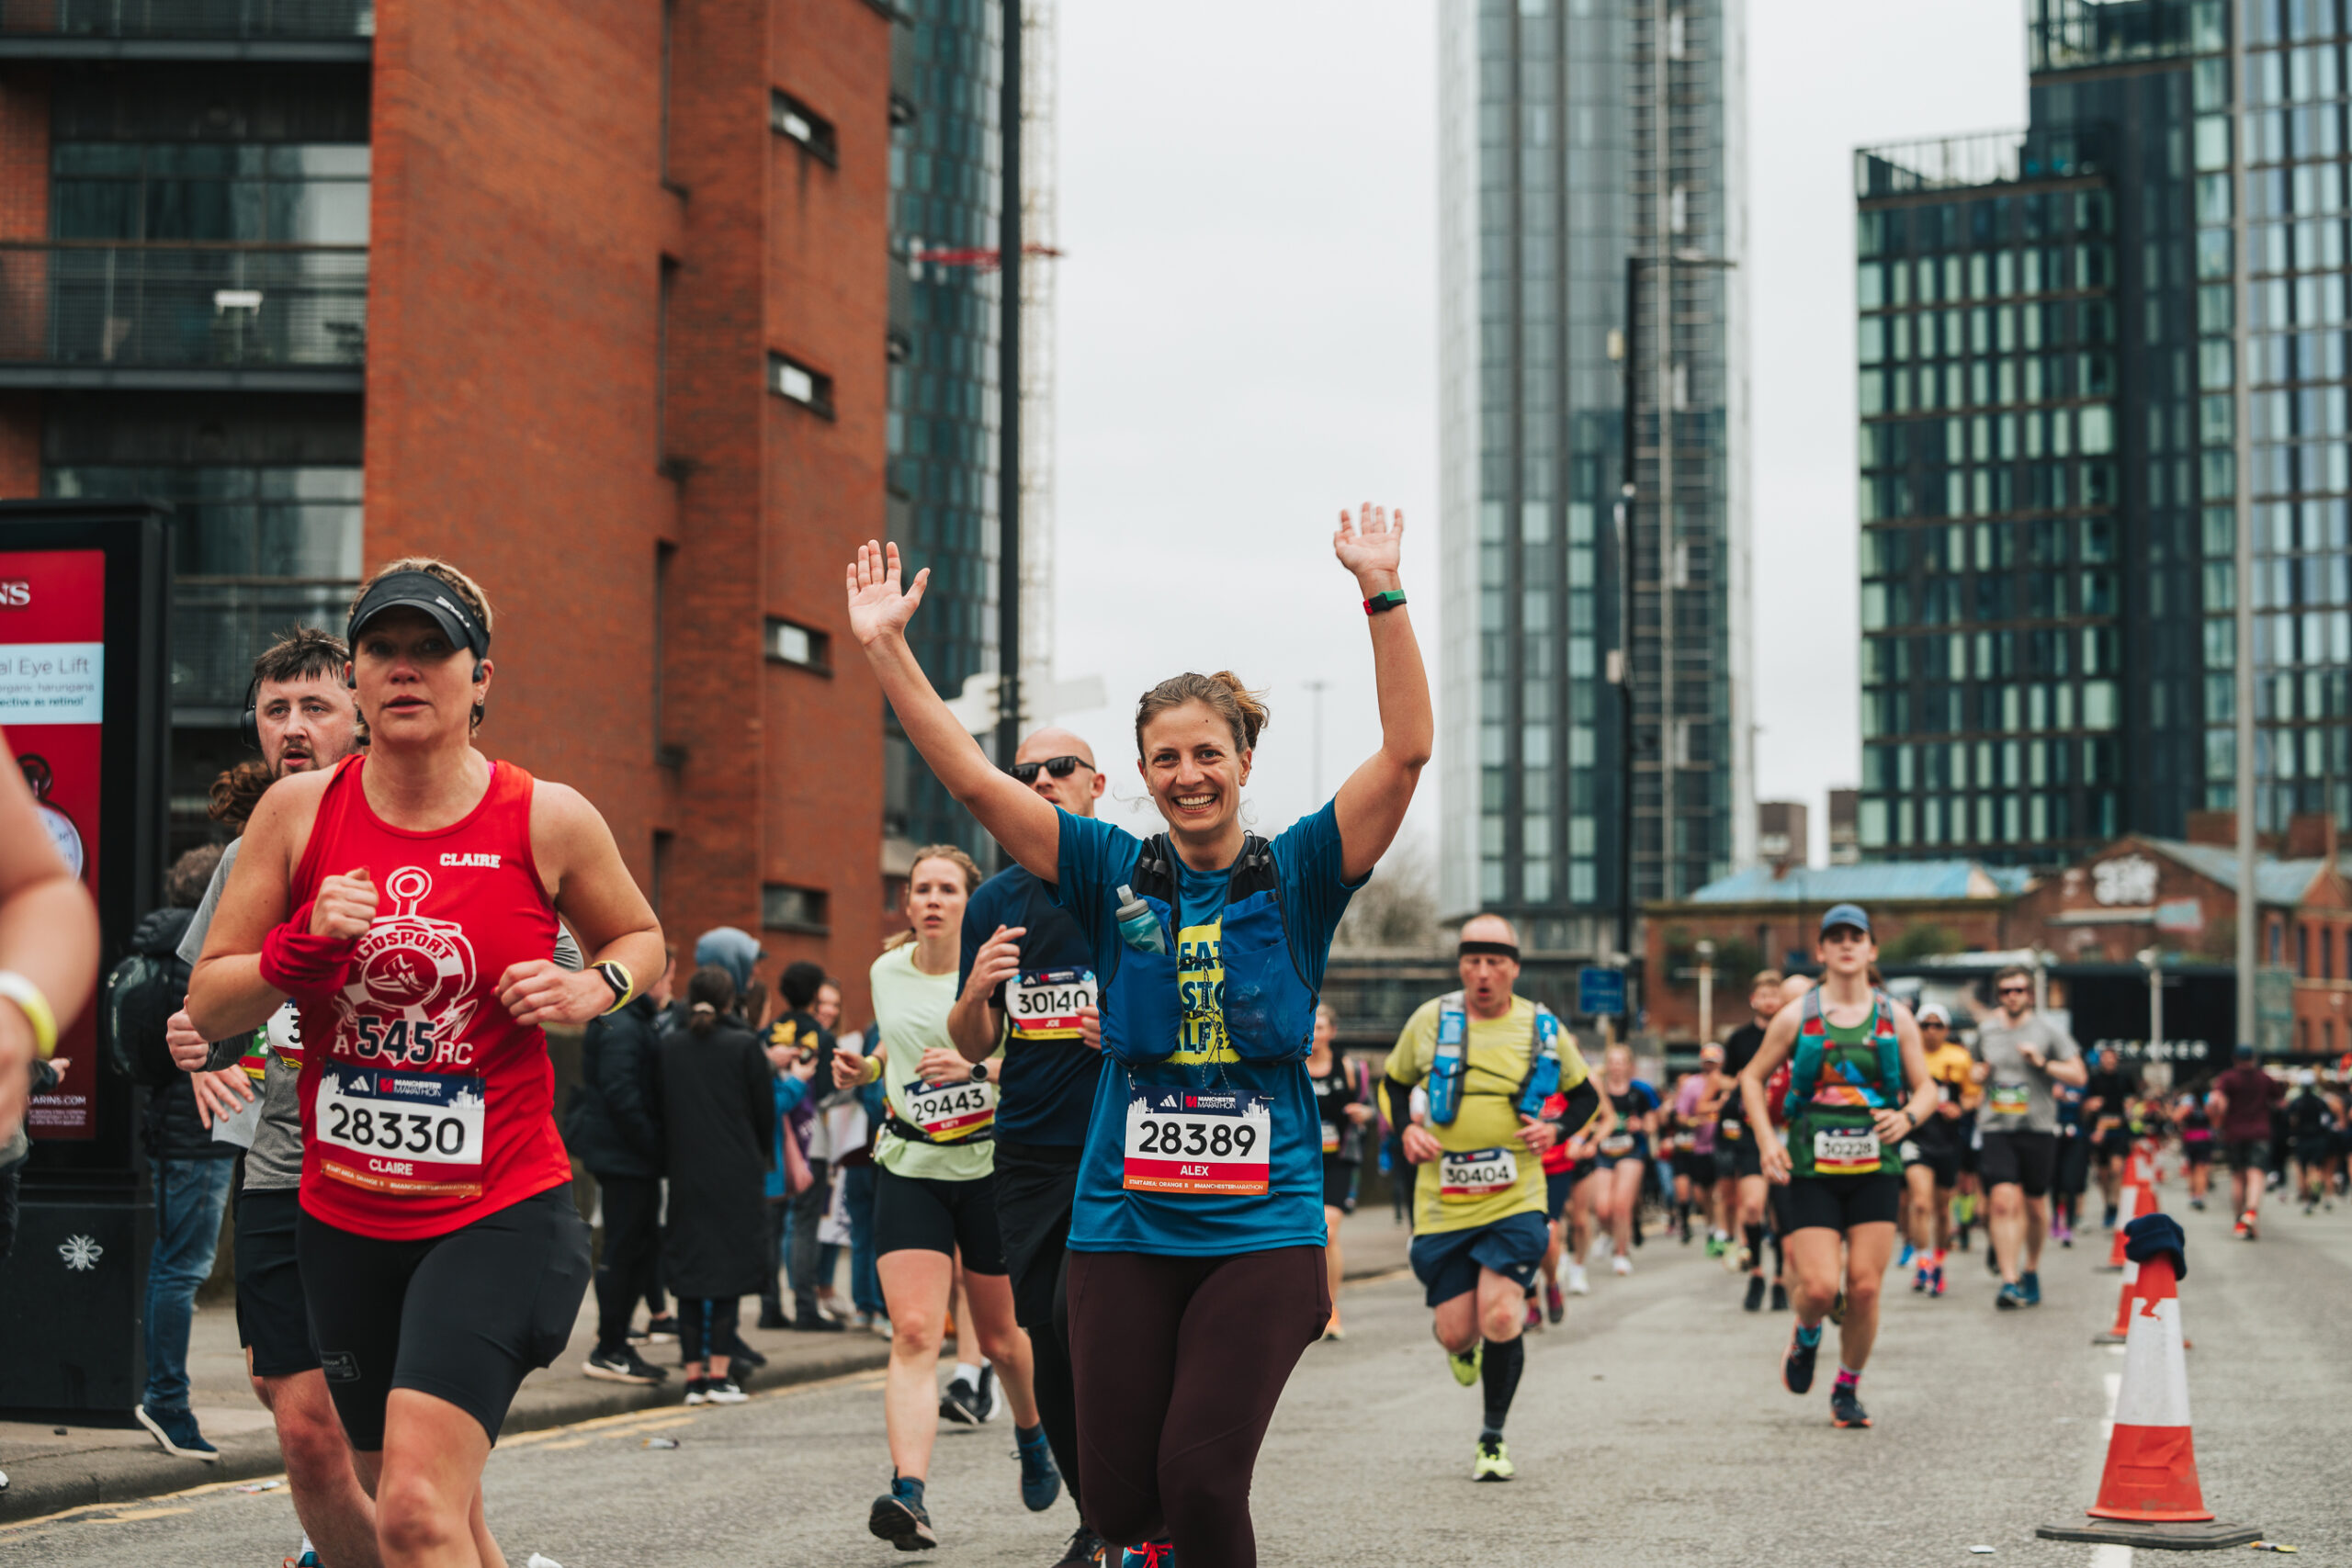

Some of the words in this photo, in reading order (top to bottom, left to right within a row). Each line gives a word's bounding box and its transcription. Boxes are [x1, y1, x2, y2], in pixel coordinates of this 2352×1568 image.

[19, 659, 52, 678] Eye
[59, 657, 90, 675] Lift
[440, 853, 501, 869] CLAIRE
[360, 931, 455, 963] GOSPORT
[1018, 990, 1089, 1014] 30140
[356, 1016, 435, 1063] 545
[435, 1040, 473, 1065] RC
[912, 1089, 985, 1122] 29443
[1198, 1101, 1236, 1110] MARATHON
[329, 1102, 465, 1156] 28330
[1139, 1120, 1256, 1157] 28389
[368, 1158, 413, 1176] CLAIRE
[1180, 1165, 1209, 1177] ALEX
[1446, 1164, 1510, 1184] 30404
[1159, 1180, 1183, 1189] ORANGE
